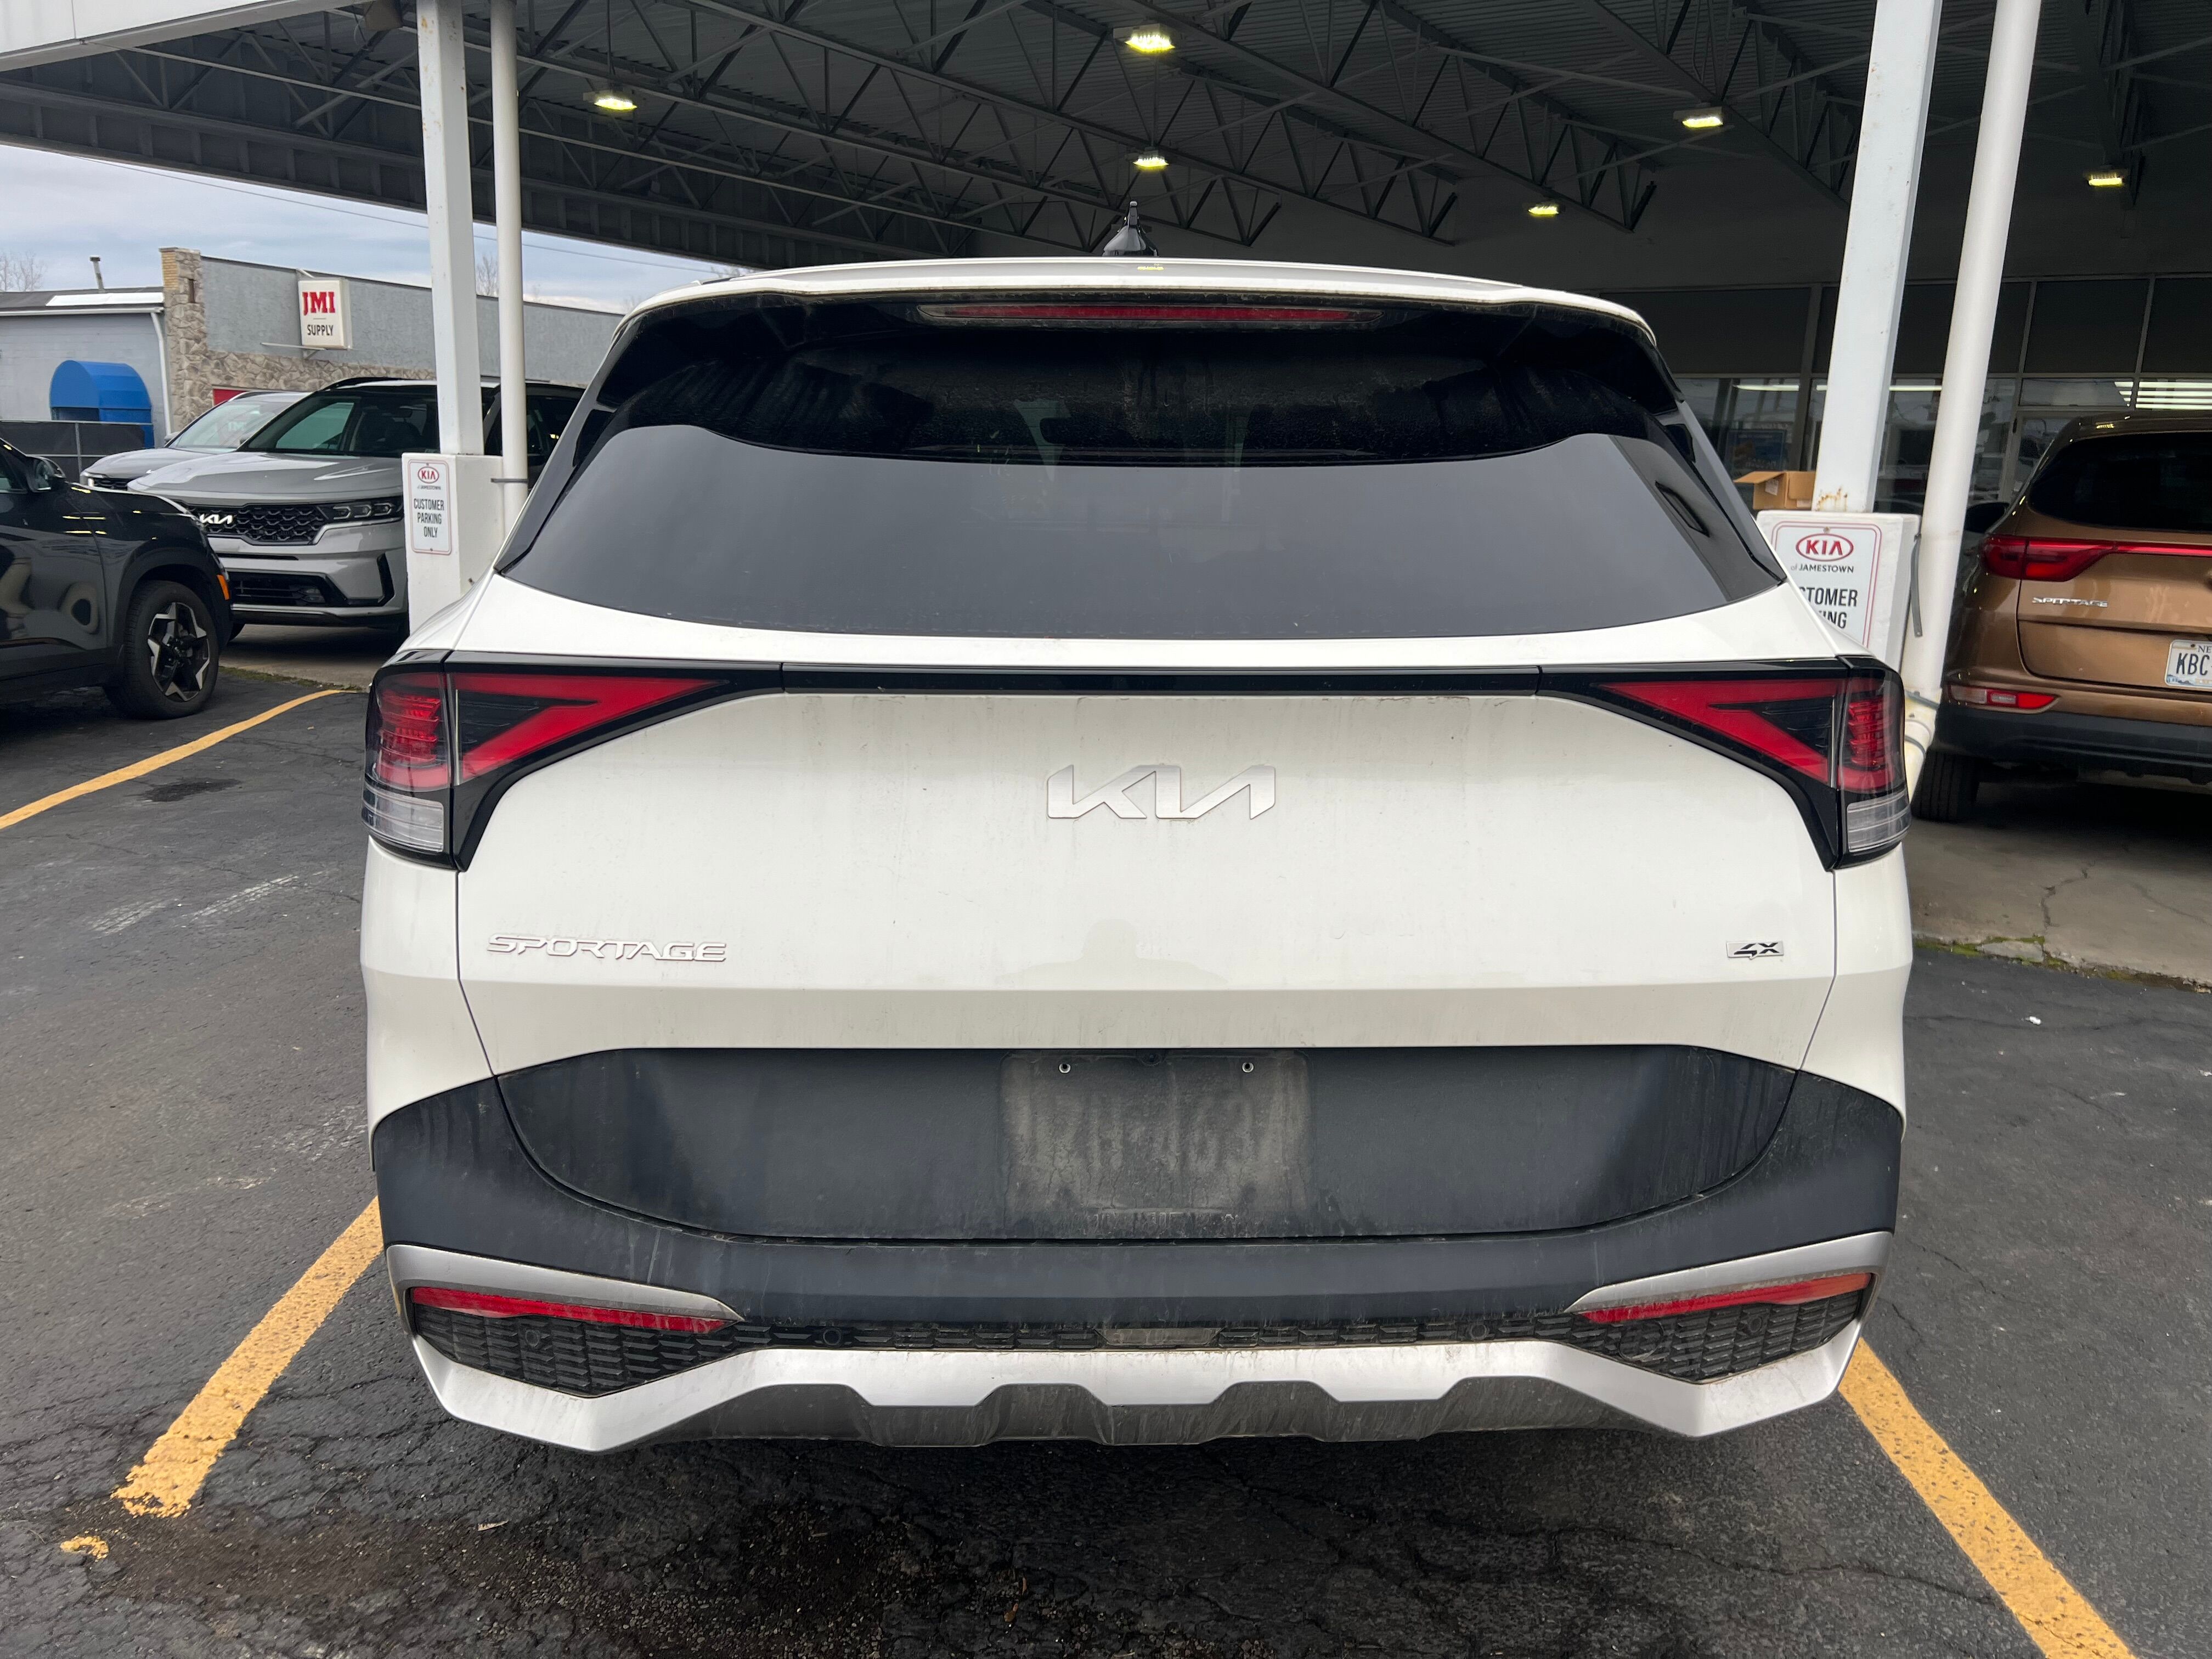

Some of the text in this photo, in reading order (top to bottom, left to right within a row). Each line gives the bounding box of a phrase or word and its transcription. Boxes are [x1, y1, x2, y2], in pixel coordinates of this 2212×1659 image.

[302, 292, 335, 316] JMI
[307, 324, 334, 336] SUPPLY
[421, 470, 436, 480] KIA
[414, 498, 444, 511] CUSTOMER
[417, 512, 442, 524] PARKING
[424, 527, 438, 538] ONLY
[1805, 539, 1843, 556] KIA
[1799, 564, 1854, 573] JAMESTOWN
[1799, 587, 1858, 607] TOMER
[2176, 652, 2210, 676] KBC
[1047, 764, 1276, 820] KIA
[487, 933, 727, 962] SPORTAGE
[1733, 941, 1780, 957] 4X
